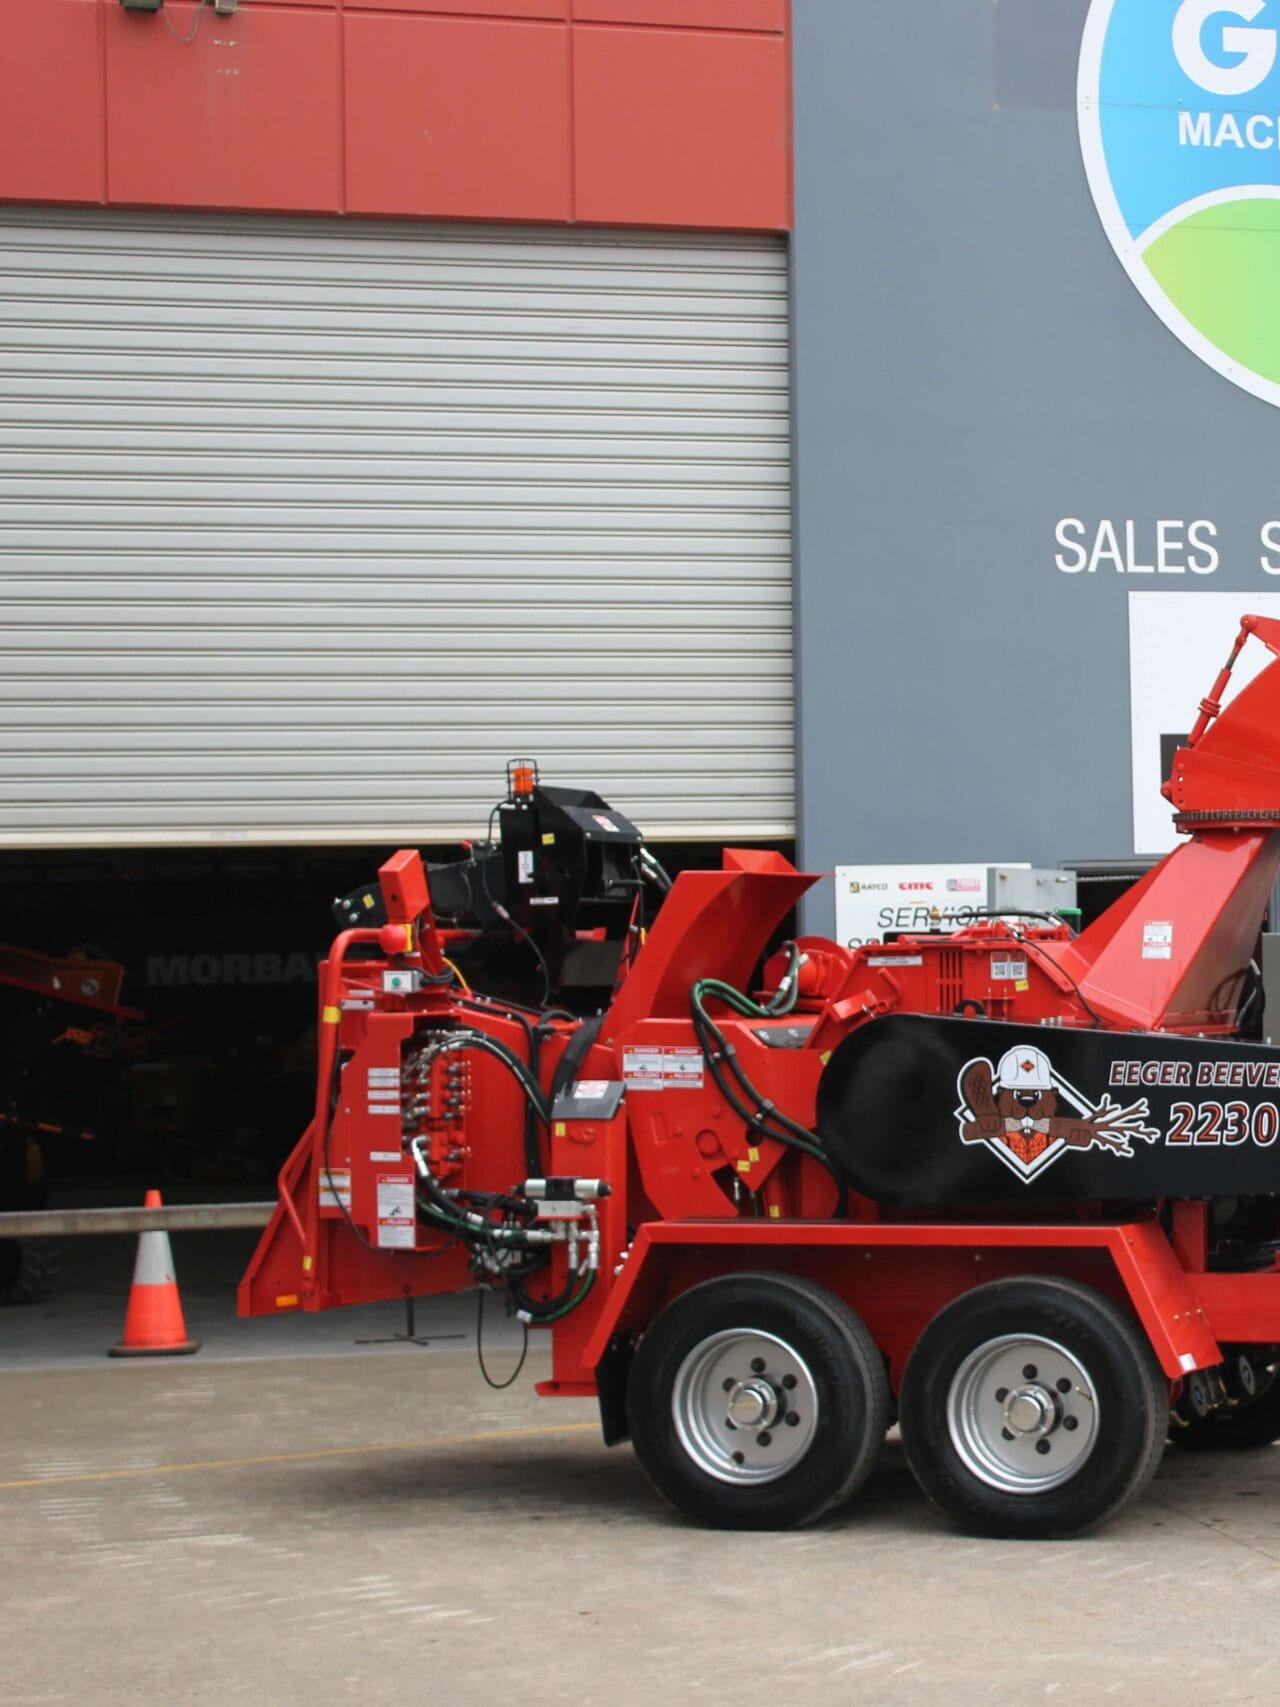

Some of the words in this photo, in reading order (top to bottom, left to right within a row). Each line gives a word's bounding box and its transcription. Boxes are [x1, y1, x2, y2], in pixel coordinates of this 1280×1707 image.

[1055, 518, 1220, 574] SALES
[1109, 1061, 1192, 1086] EEGER
[1165, 1101, 1279, 1147] 2230
